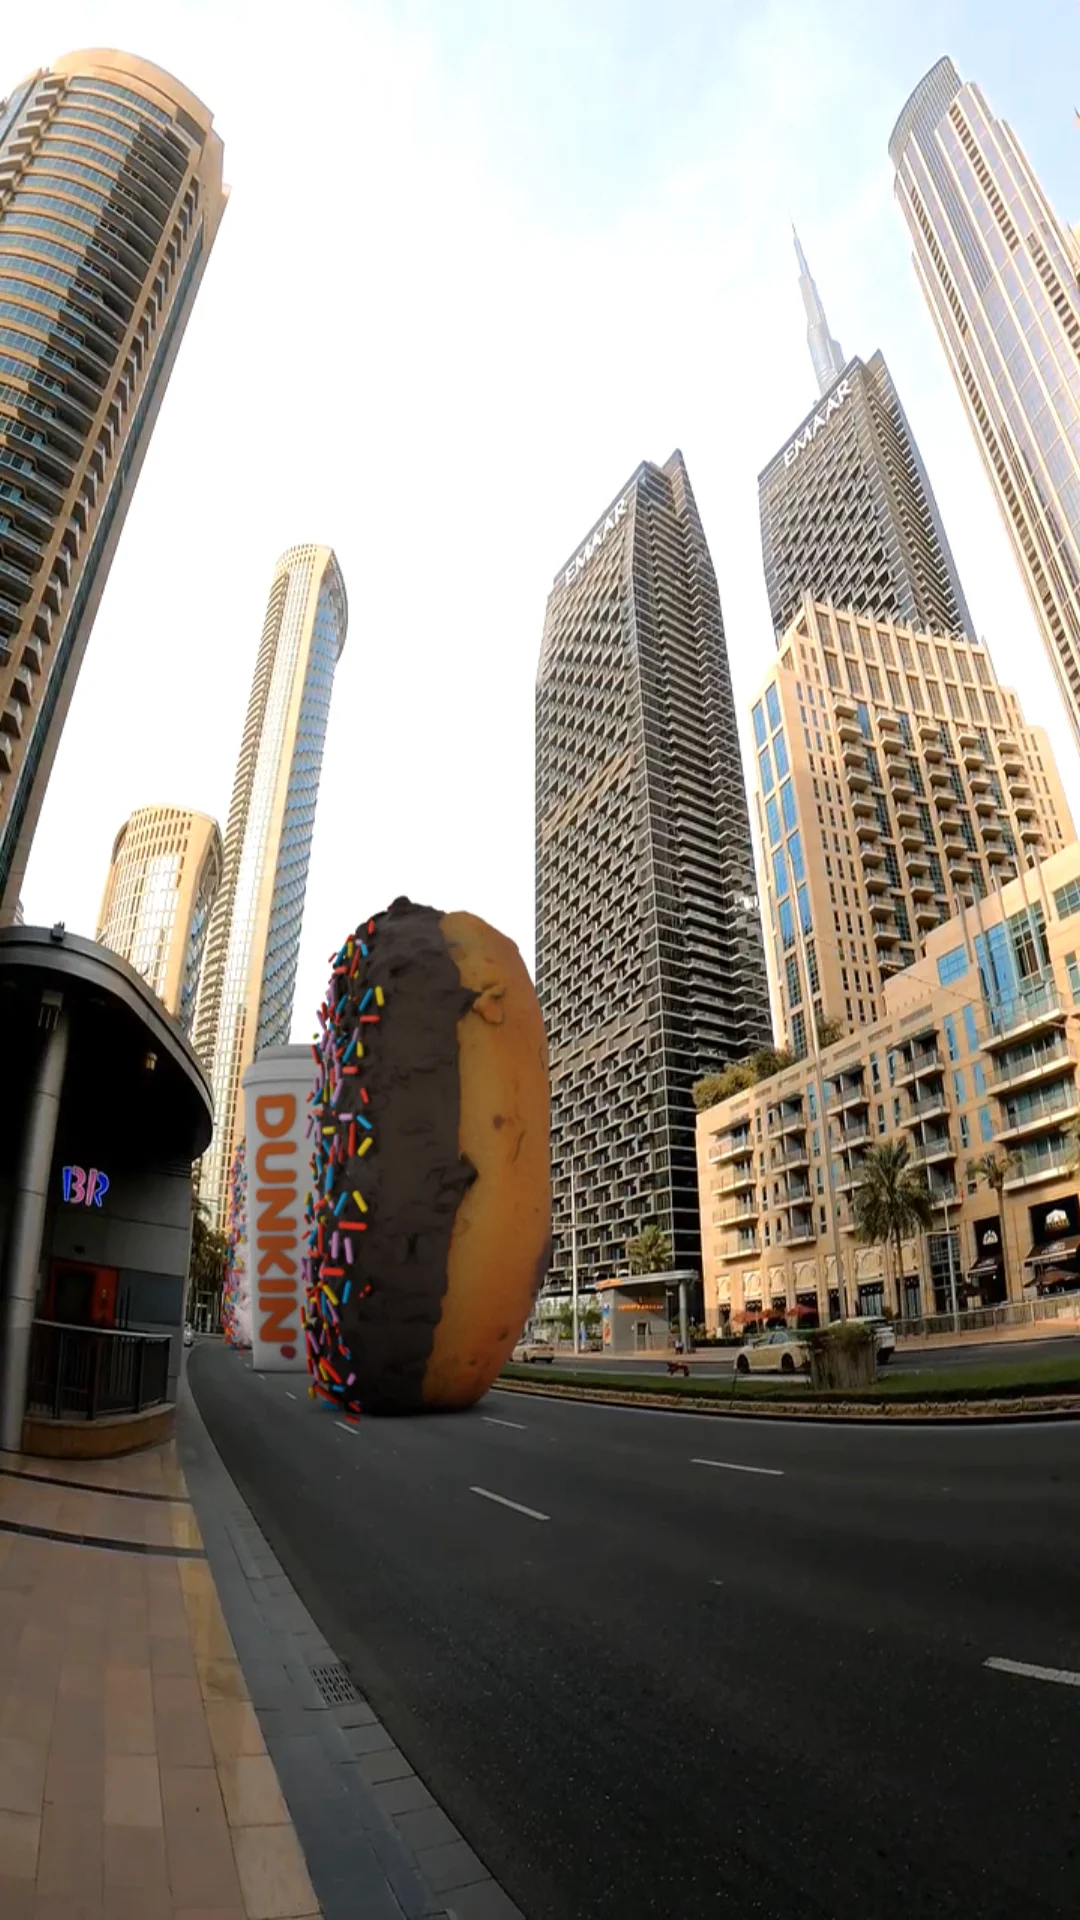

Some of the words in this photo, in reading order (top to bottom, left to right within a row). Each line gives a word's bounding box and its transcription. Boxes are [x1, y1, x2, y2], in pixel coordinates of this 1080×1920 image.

[783, 379, 852, 468] EMAAR
[564, 498, 627, 586] EMAAR
[62, 1165, 109, 1207] BR
